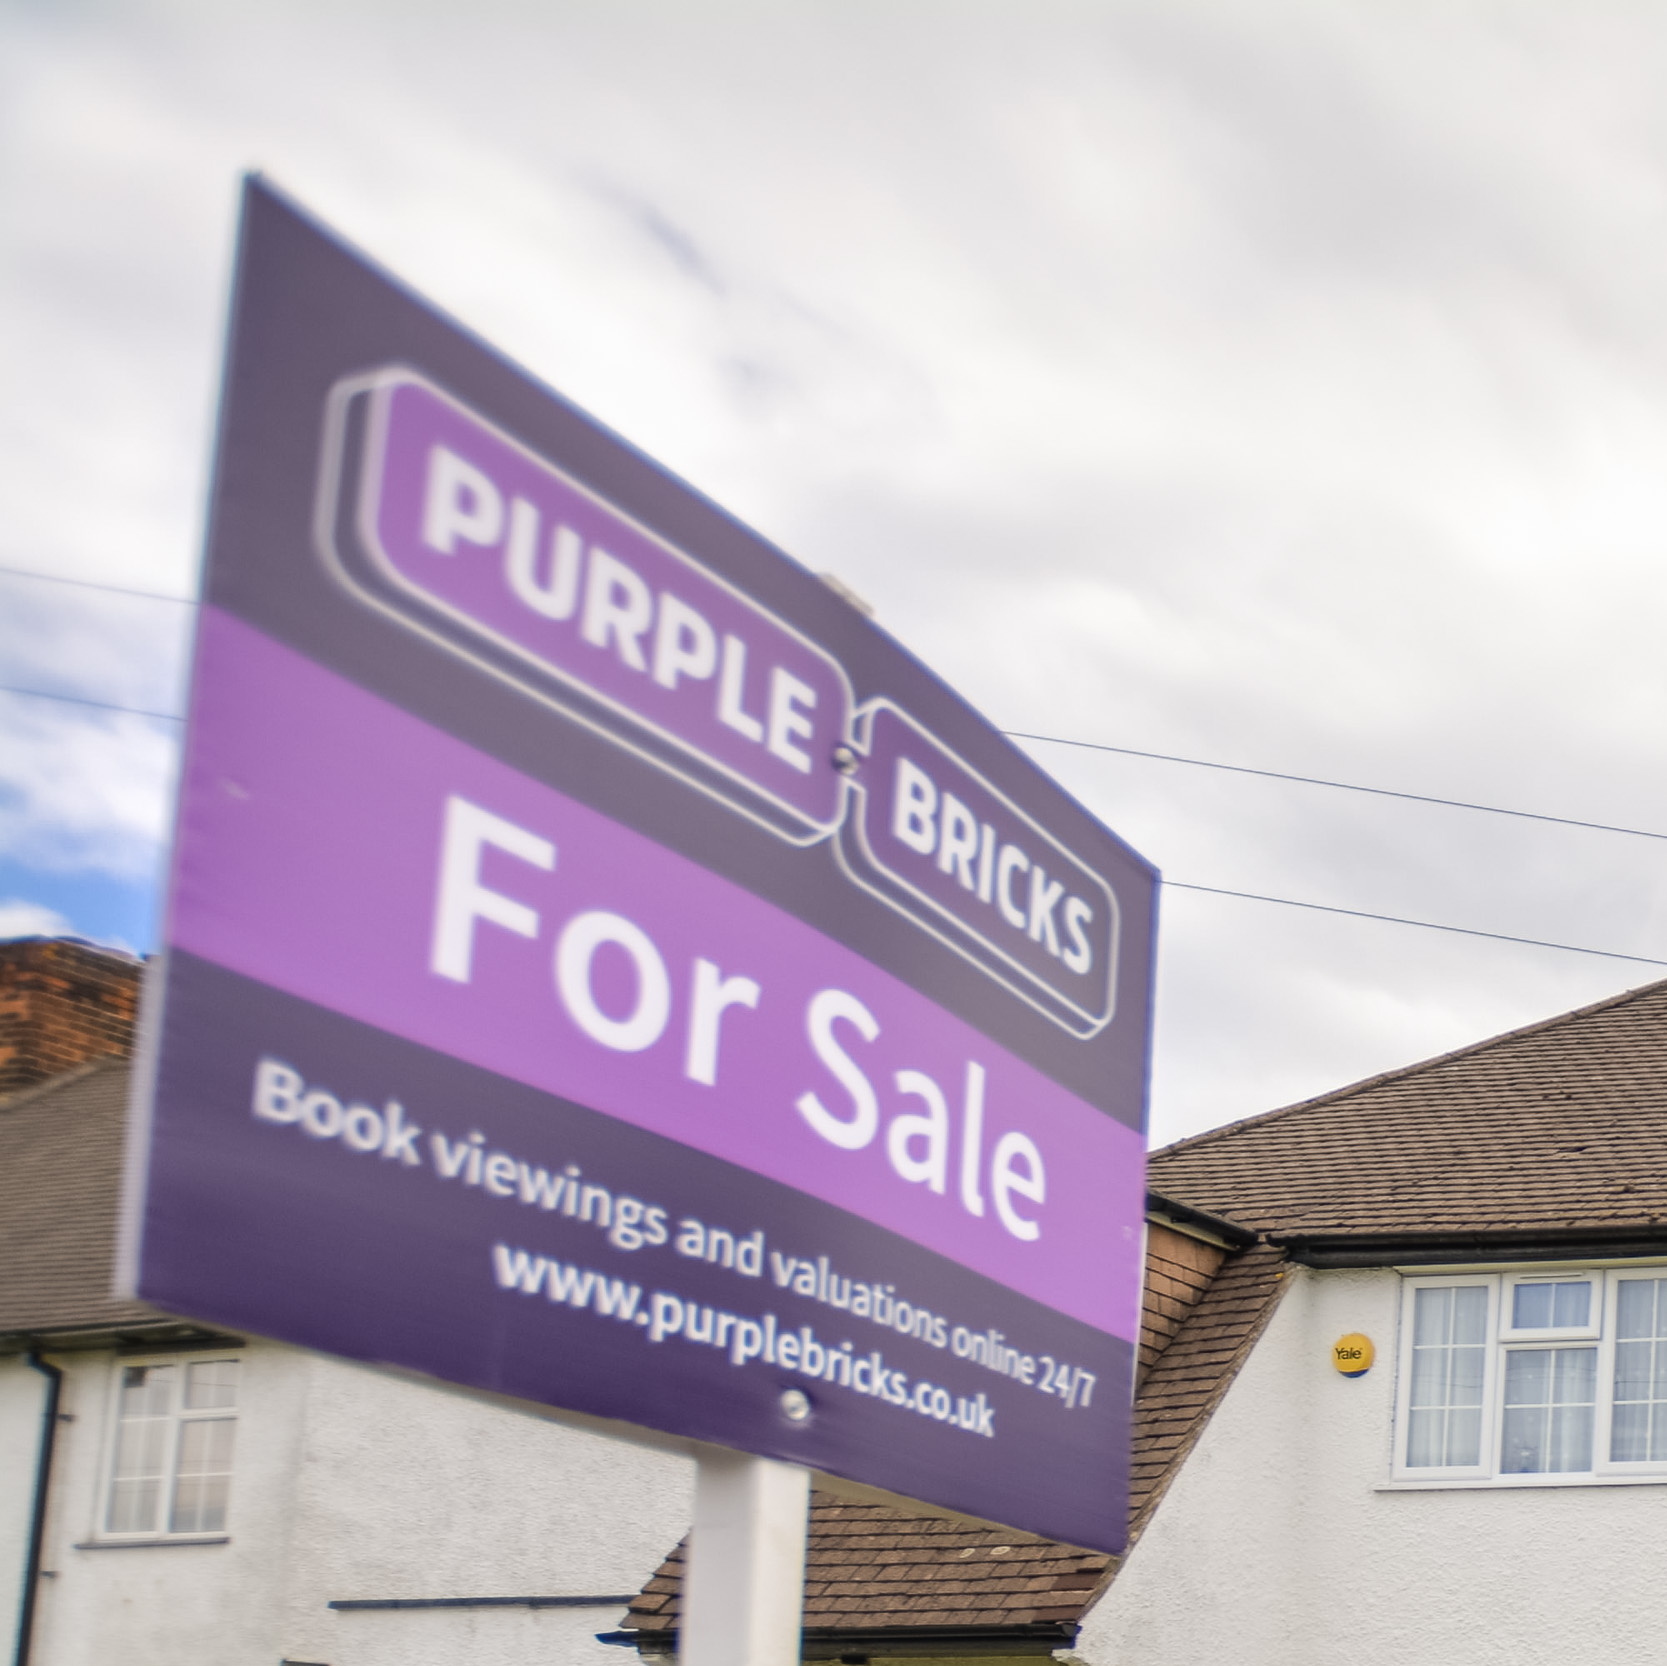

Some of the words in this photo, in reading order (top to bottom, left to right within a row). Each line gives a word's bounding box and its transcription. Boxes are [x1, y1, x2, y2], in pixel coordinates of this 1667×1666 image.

[421, 442, 817, 775] PURPLE
[893, 756, 1093, 975] BRICKS
[430, 794, 762, 1087] For
[796, 988, 1046, 1242] Sale
[252, 1055, 423, 1167] Book
[430, 1130, 669, 1251] viewings
[674, 1210, 765, 1278] and
[770, 1255, 948, 1349] valuations
[951, 1328, 1037, 1386] online
[1036, 1355, 1096, 1409] 24/7
[493, 1242, 996, 1438] www.purplebricks.co.uk
[1335, 1347, 1362, 1360] Yale
